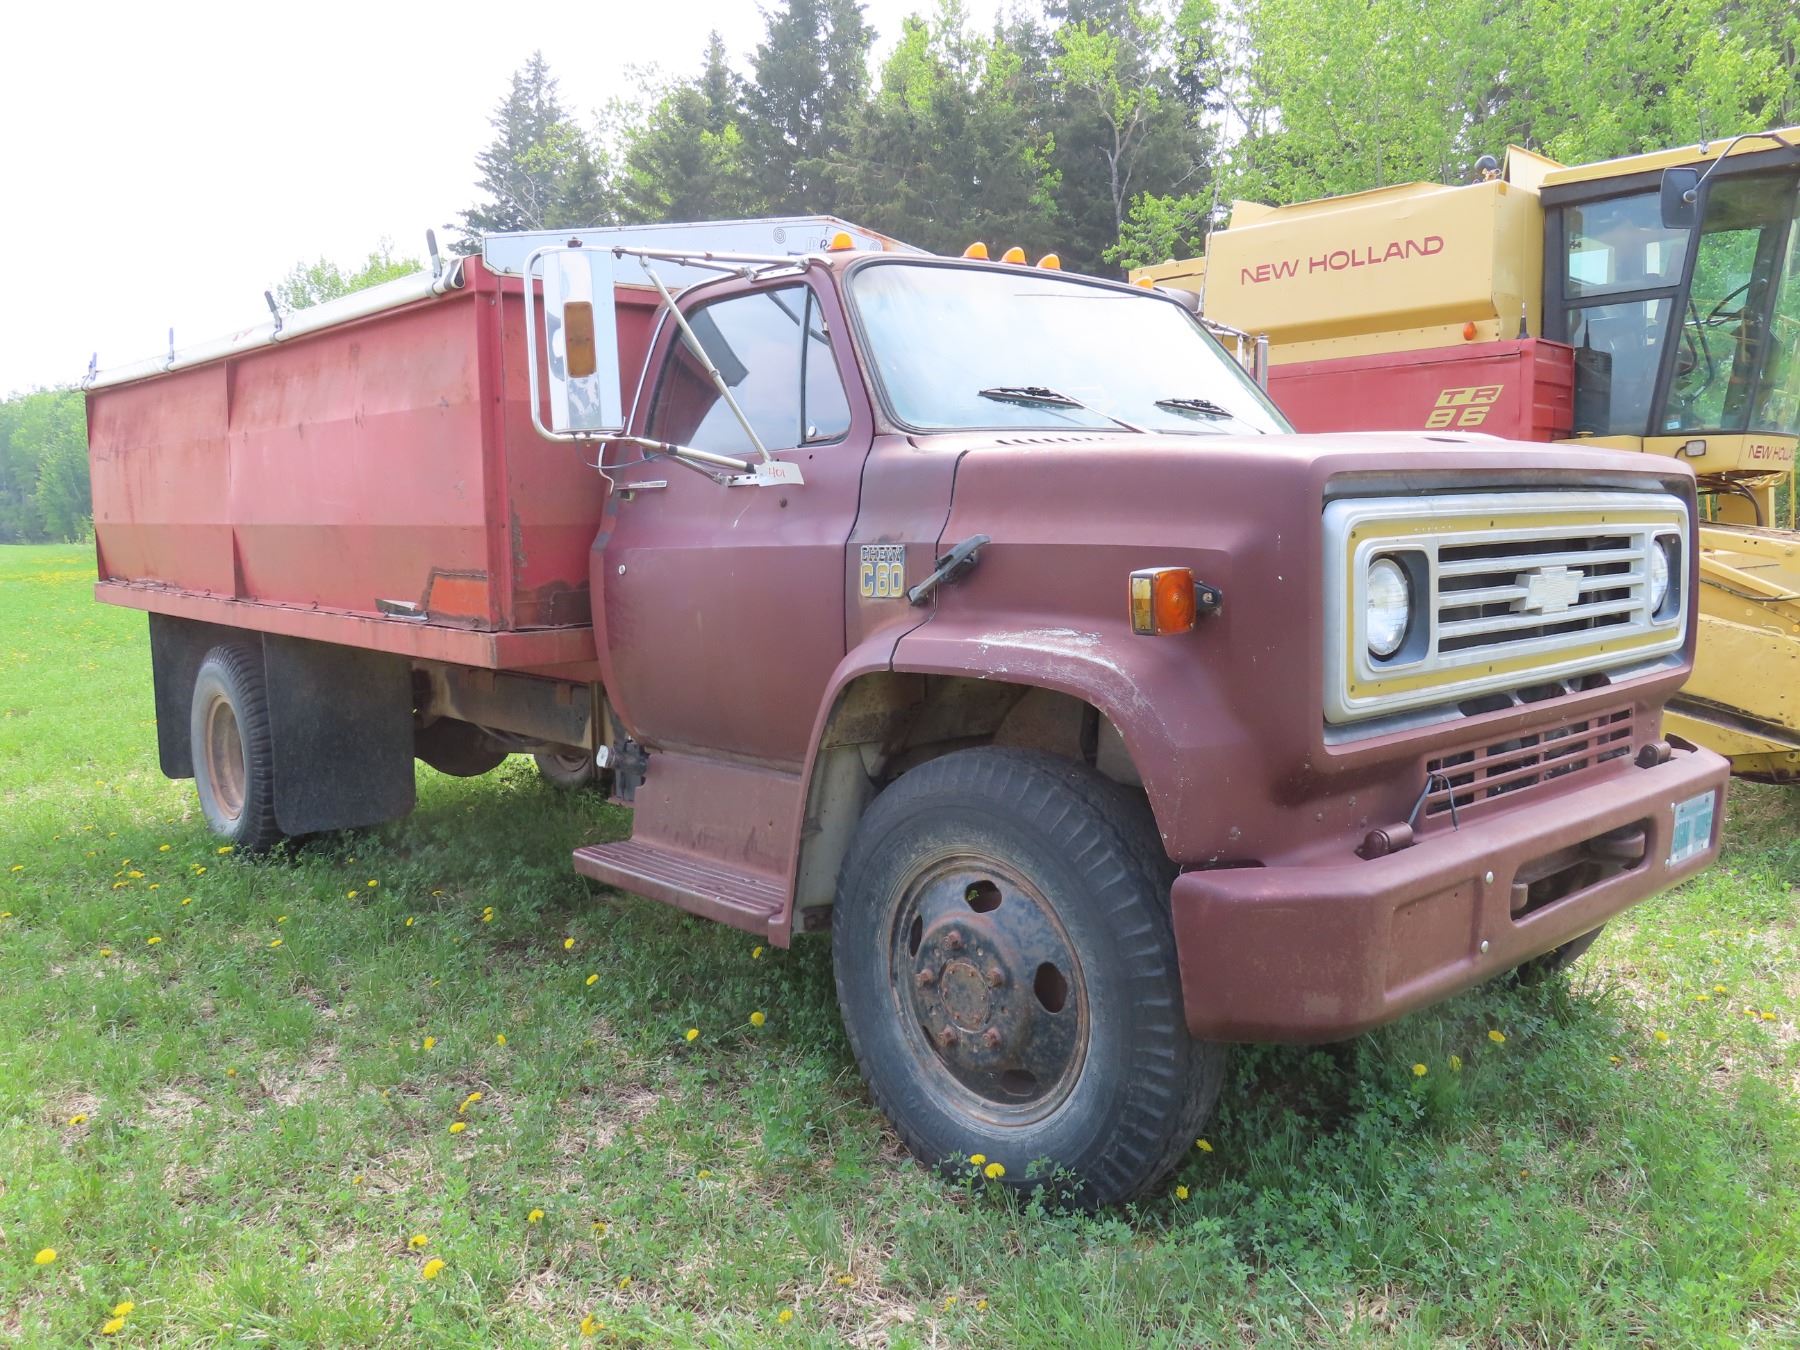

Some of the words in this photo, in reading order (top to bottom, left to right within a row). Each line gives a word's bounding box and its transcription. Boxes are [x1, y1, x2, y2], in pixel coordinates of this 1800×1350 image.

[1241, 259, 1299, 286] NEW
[1308, 235, 1444, 274] HOLLAND
[1439, 387, 1500, 404] TR
[1425, 406, 1490, 428] 86
[1748, 444, 1773, 460] NEW
[861, 545, 904, 562] CHEVY
[861, 562, 904, 597] C60
